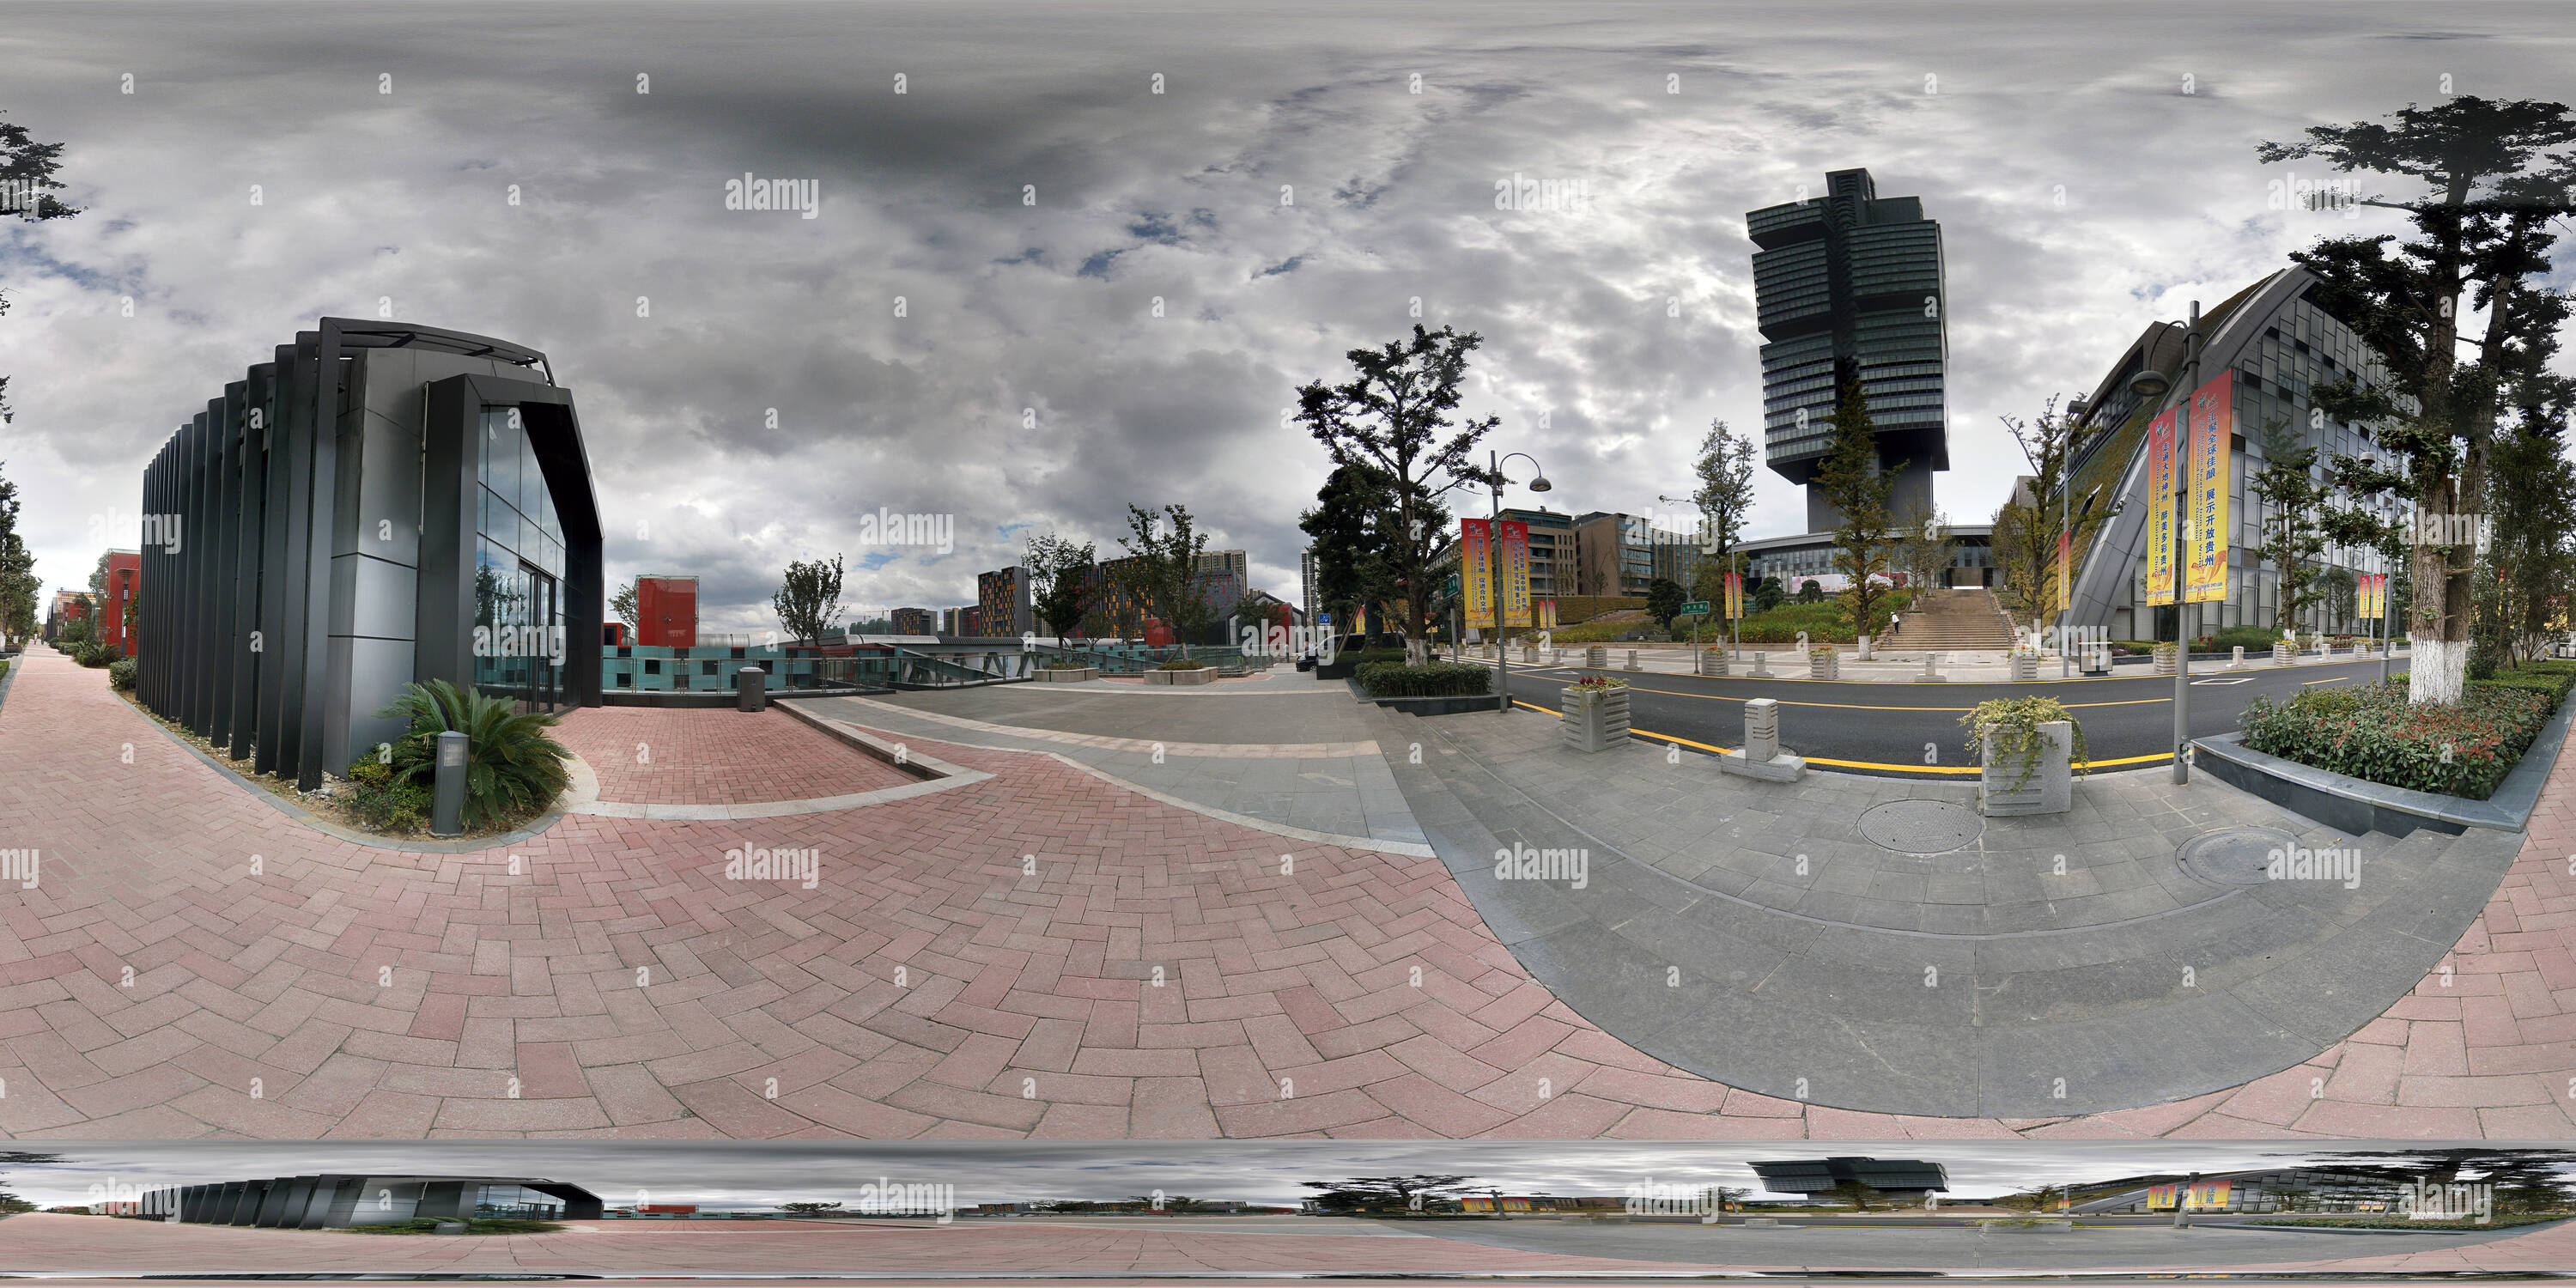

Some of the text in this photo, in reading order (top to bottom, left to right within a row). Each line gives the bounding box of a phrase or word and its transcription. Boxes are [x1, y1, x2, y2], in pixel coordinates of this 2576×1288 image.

[2204, 412, 2218, 567] 汇聚全球佳酿 展示开放贵州
